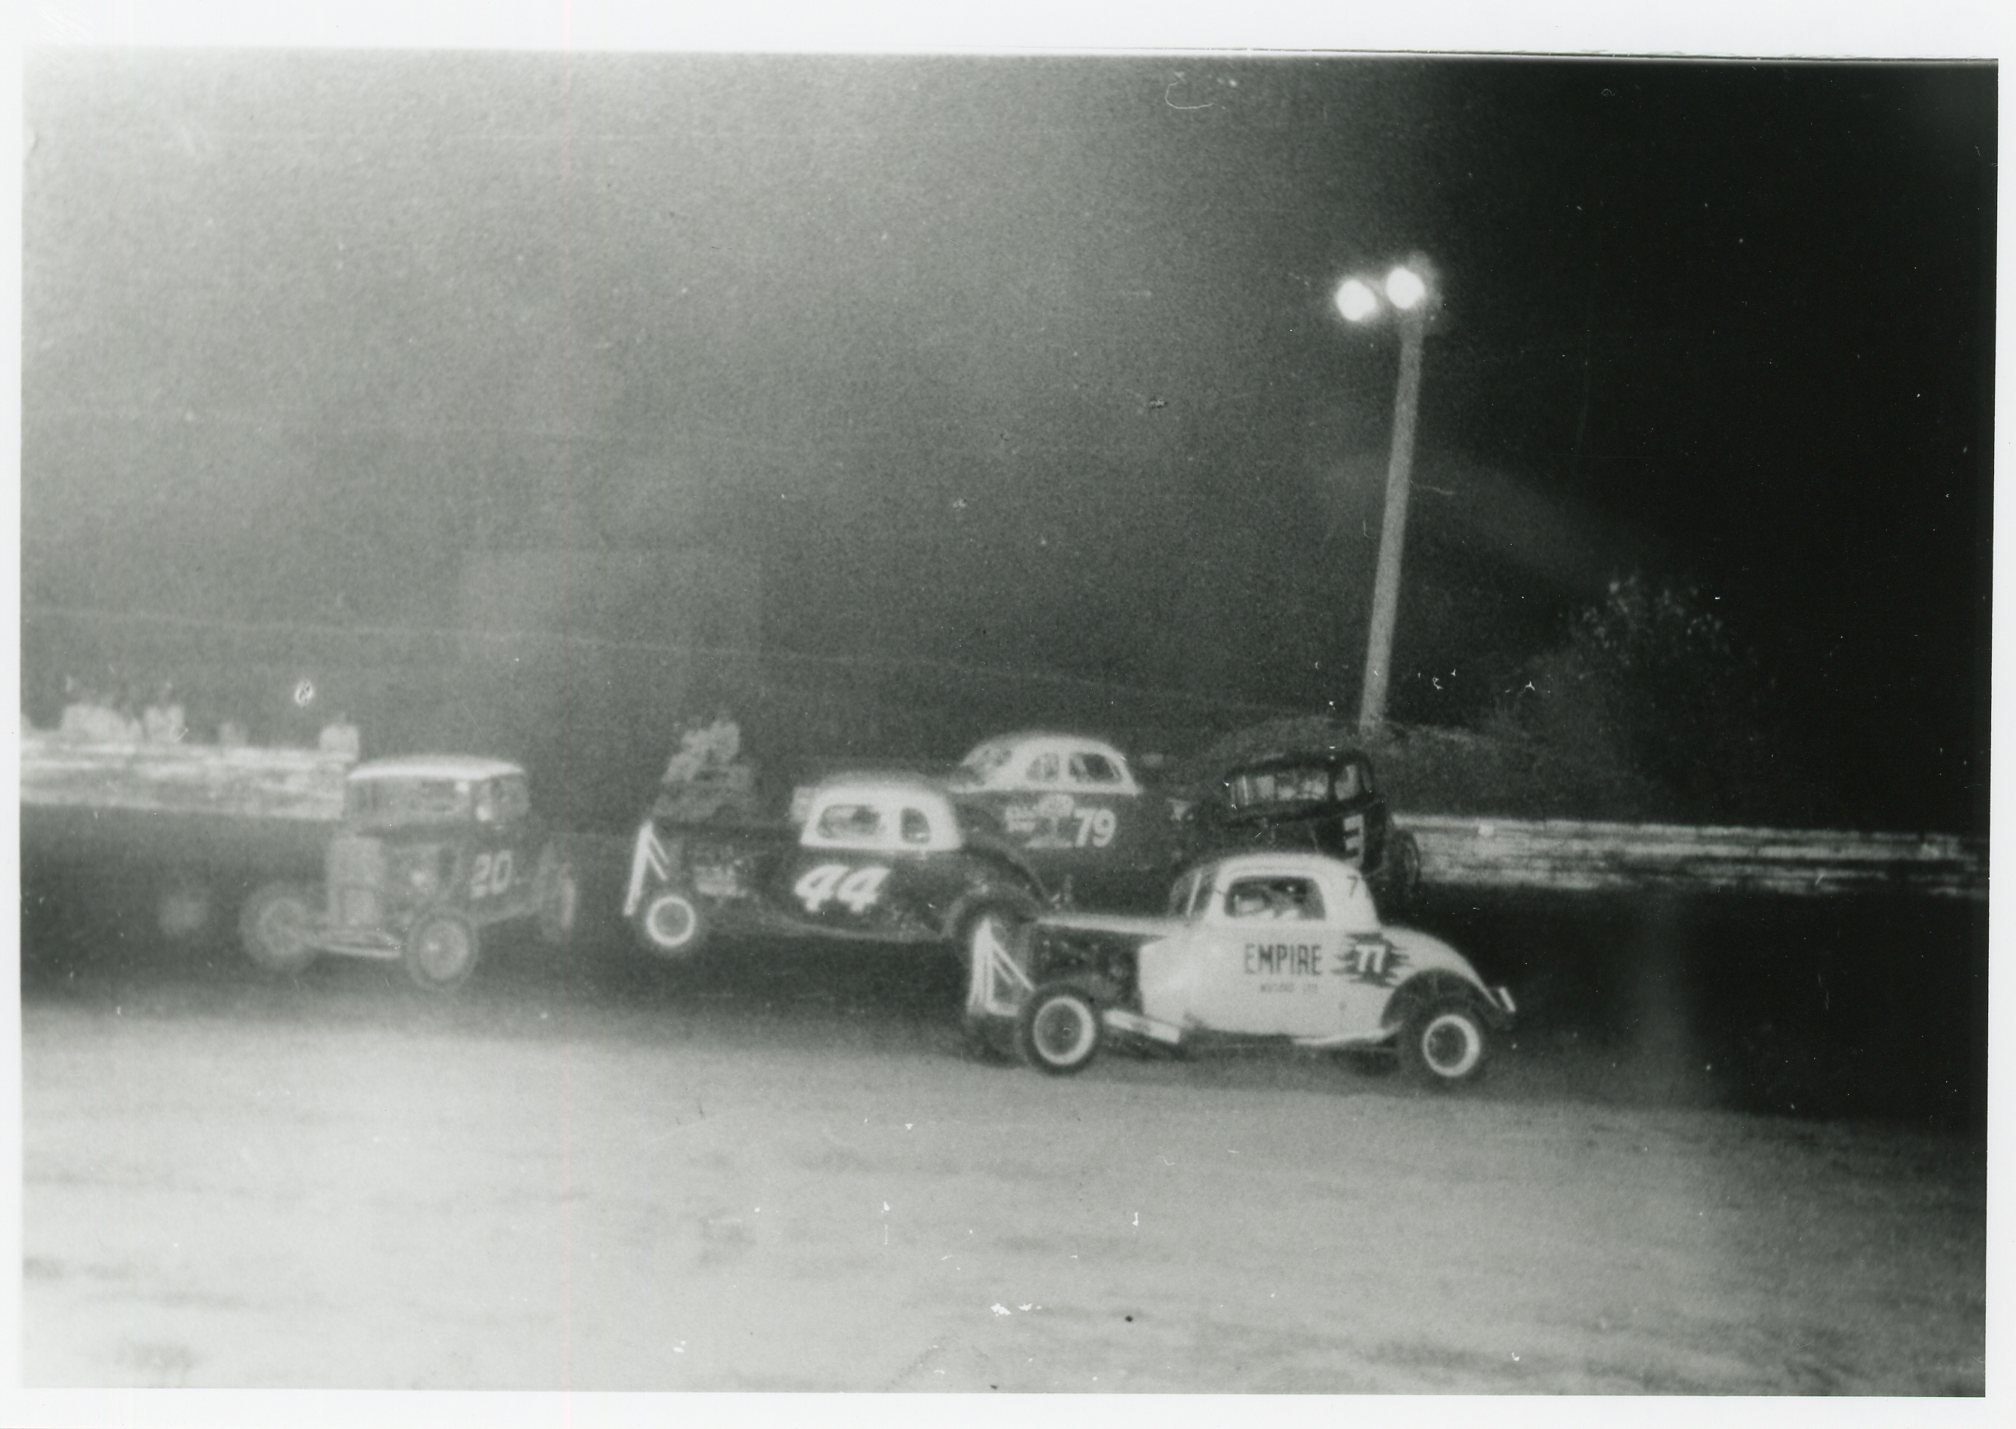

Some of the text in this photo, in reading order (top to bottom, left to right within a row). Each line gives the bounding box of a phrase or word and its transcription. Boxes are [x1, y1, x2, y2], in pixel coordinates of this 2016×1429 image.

[1073, 808, 1116, 848] 79
[470, 850, 513, 899] 20
[795, 863, 892, 913] 44
[1244, 943, 1322, 976] EMPIRE
[1354, 943, 1387, 974] 77
